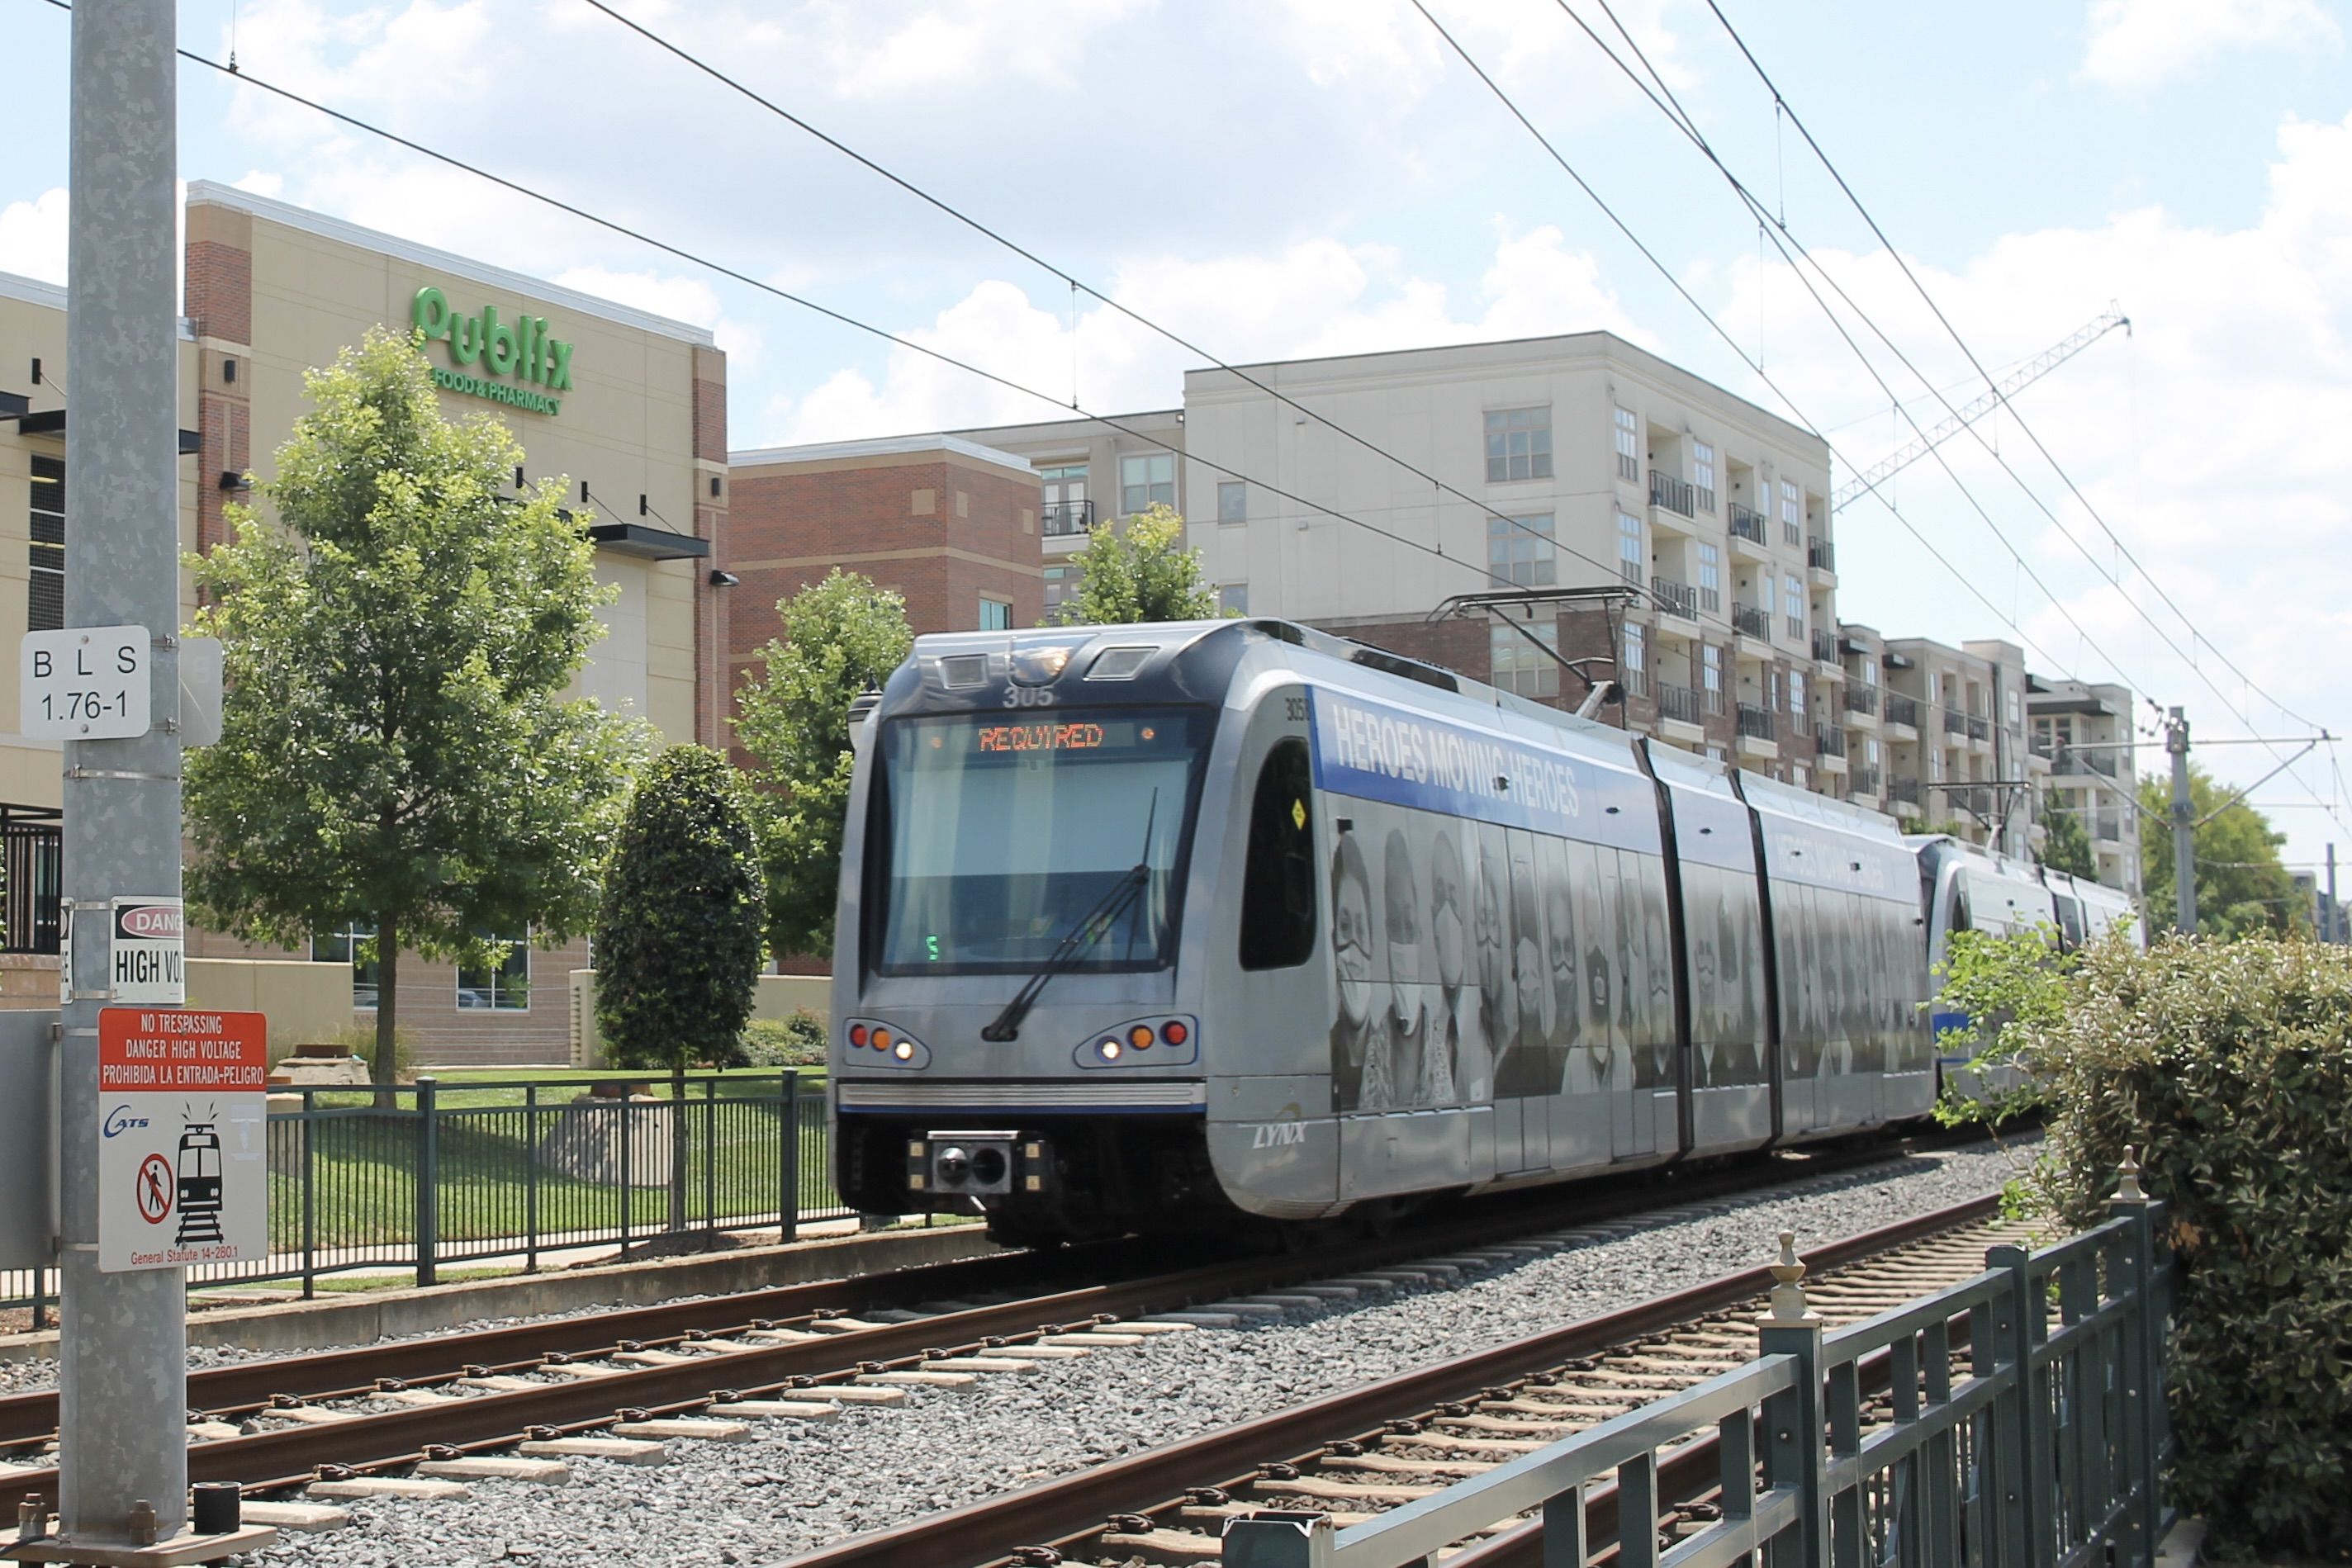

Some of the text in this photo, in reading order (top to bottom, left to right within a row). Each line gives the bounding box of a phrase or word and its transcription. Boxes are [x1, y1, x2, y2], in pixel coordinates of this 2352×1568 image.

[415, 287, 575, 392] Publix
[435, 368, 562, 416] FOOD & PHARMACY
[41, 689, 126, 721] 1.76-1
[1002, 685, 1055, 709] 305
[978, 722, 1105, 751] REQUIRED
[1332, 703, 1579, 818] HEROES MOVING HEROES
[116, 950, 159, 983] HIGH
[141, 1013, 222, 1035] NO TRESPASSING
[126, 1039, 242, 1059] DANGER HIGH VOLTAGE
[103, 1064, 264, 1085] PROHIBIDA LA ENTRADA-PELIGRO
[1252, 1121, 1308, 1149] LYNX
[130, 1245, 238, 1265] General Statute 14-280.1
